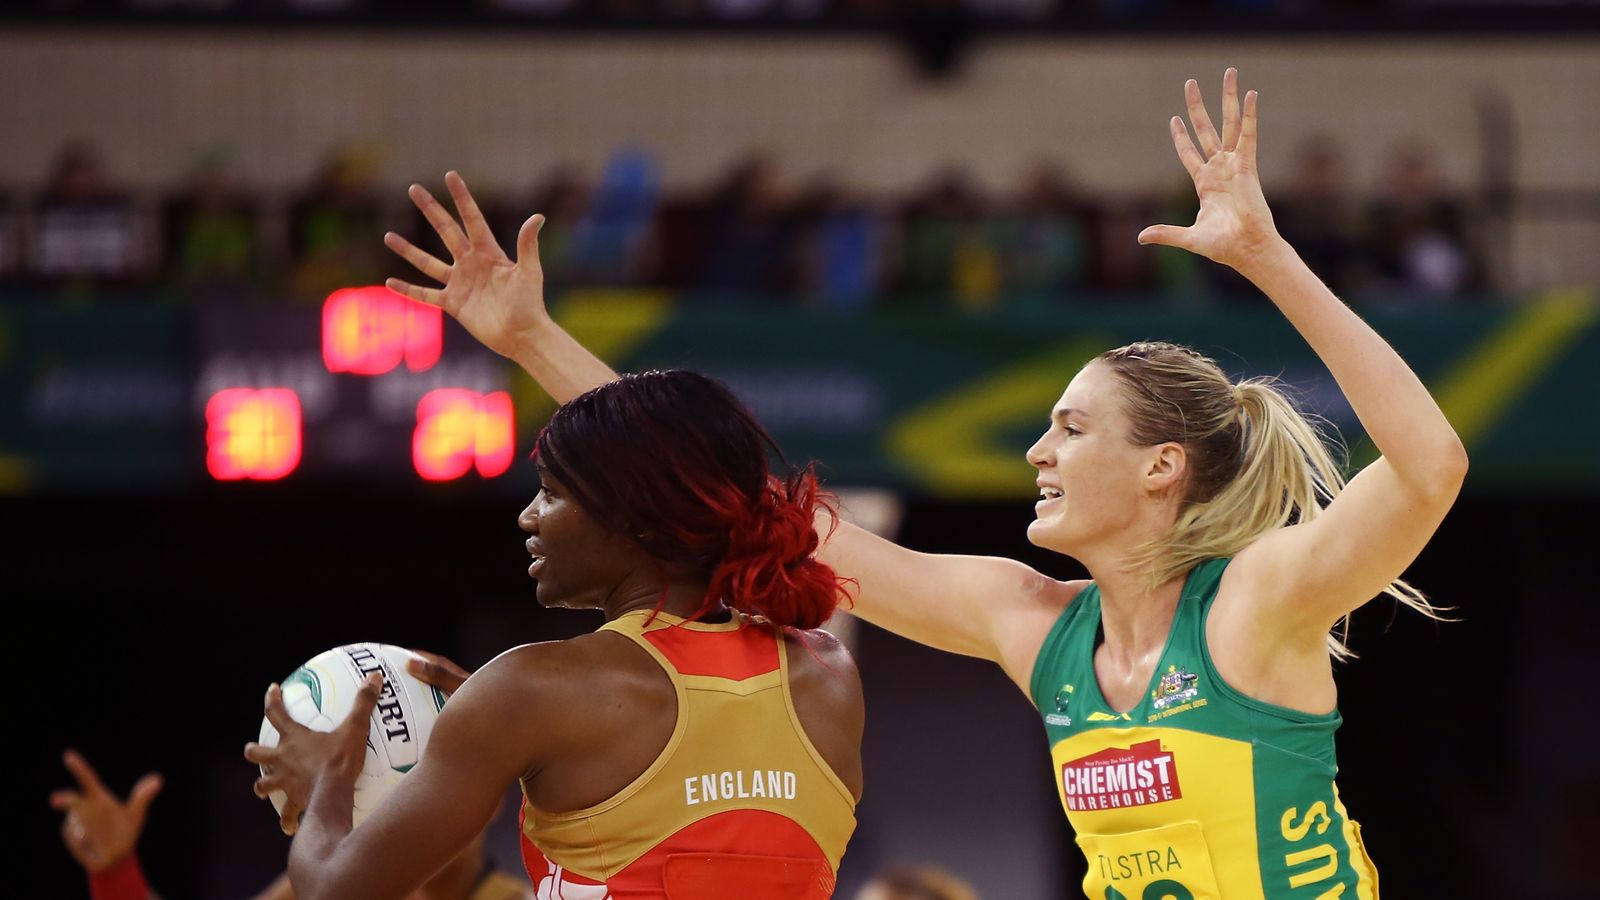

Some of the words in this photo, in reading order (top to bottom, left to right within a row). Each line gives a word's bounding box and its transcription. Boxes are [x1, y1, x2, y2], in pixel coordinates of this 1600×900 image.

[345, 647, 411, 743] ILERT
[684, 769, 797, 805] ENGLAND
[1064, 755, 1171, 795] CHEMIST
[1067, 786, 1173, 810] WAREHOUSE
